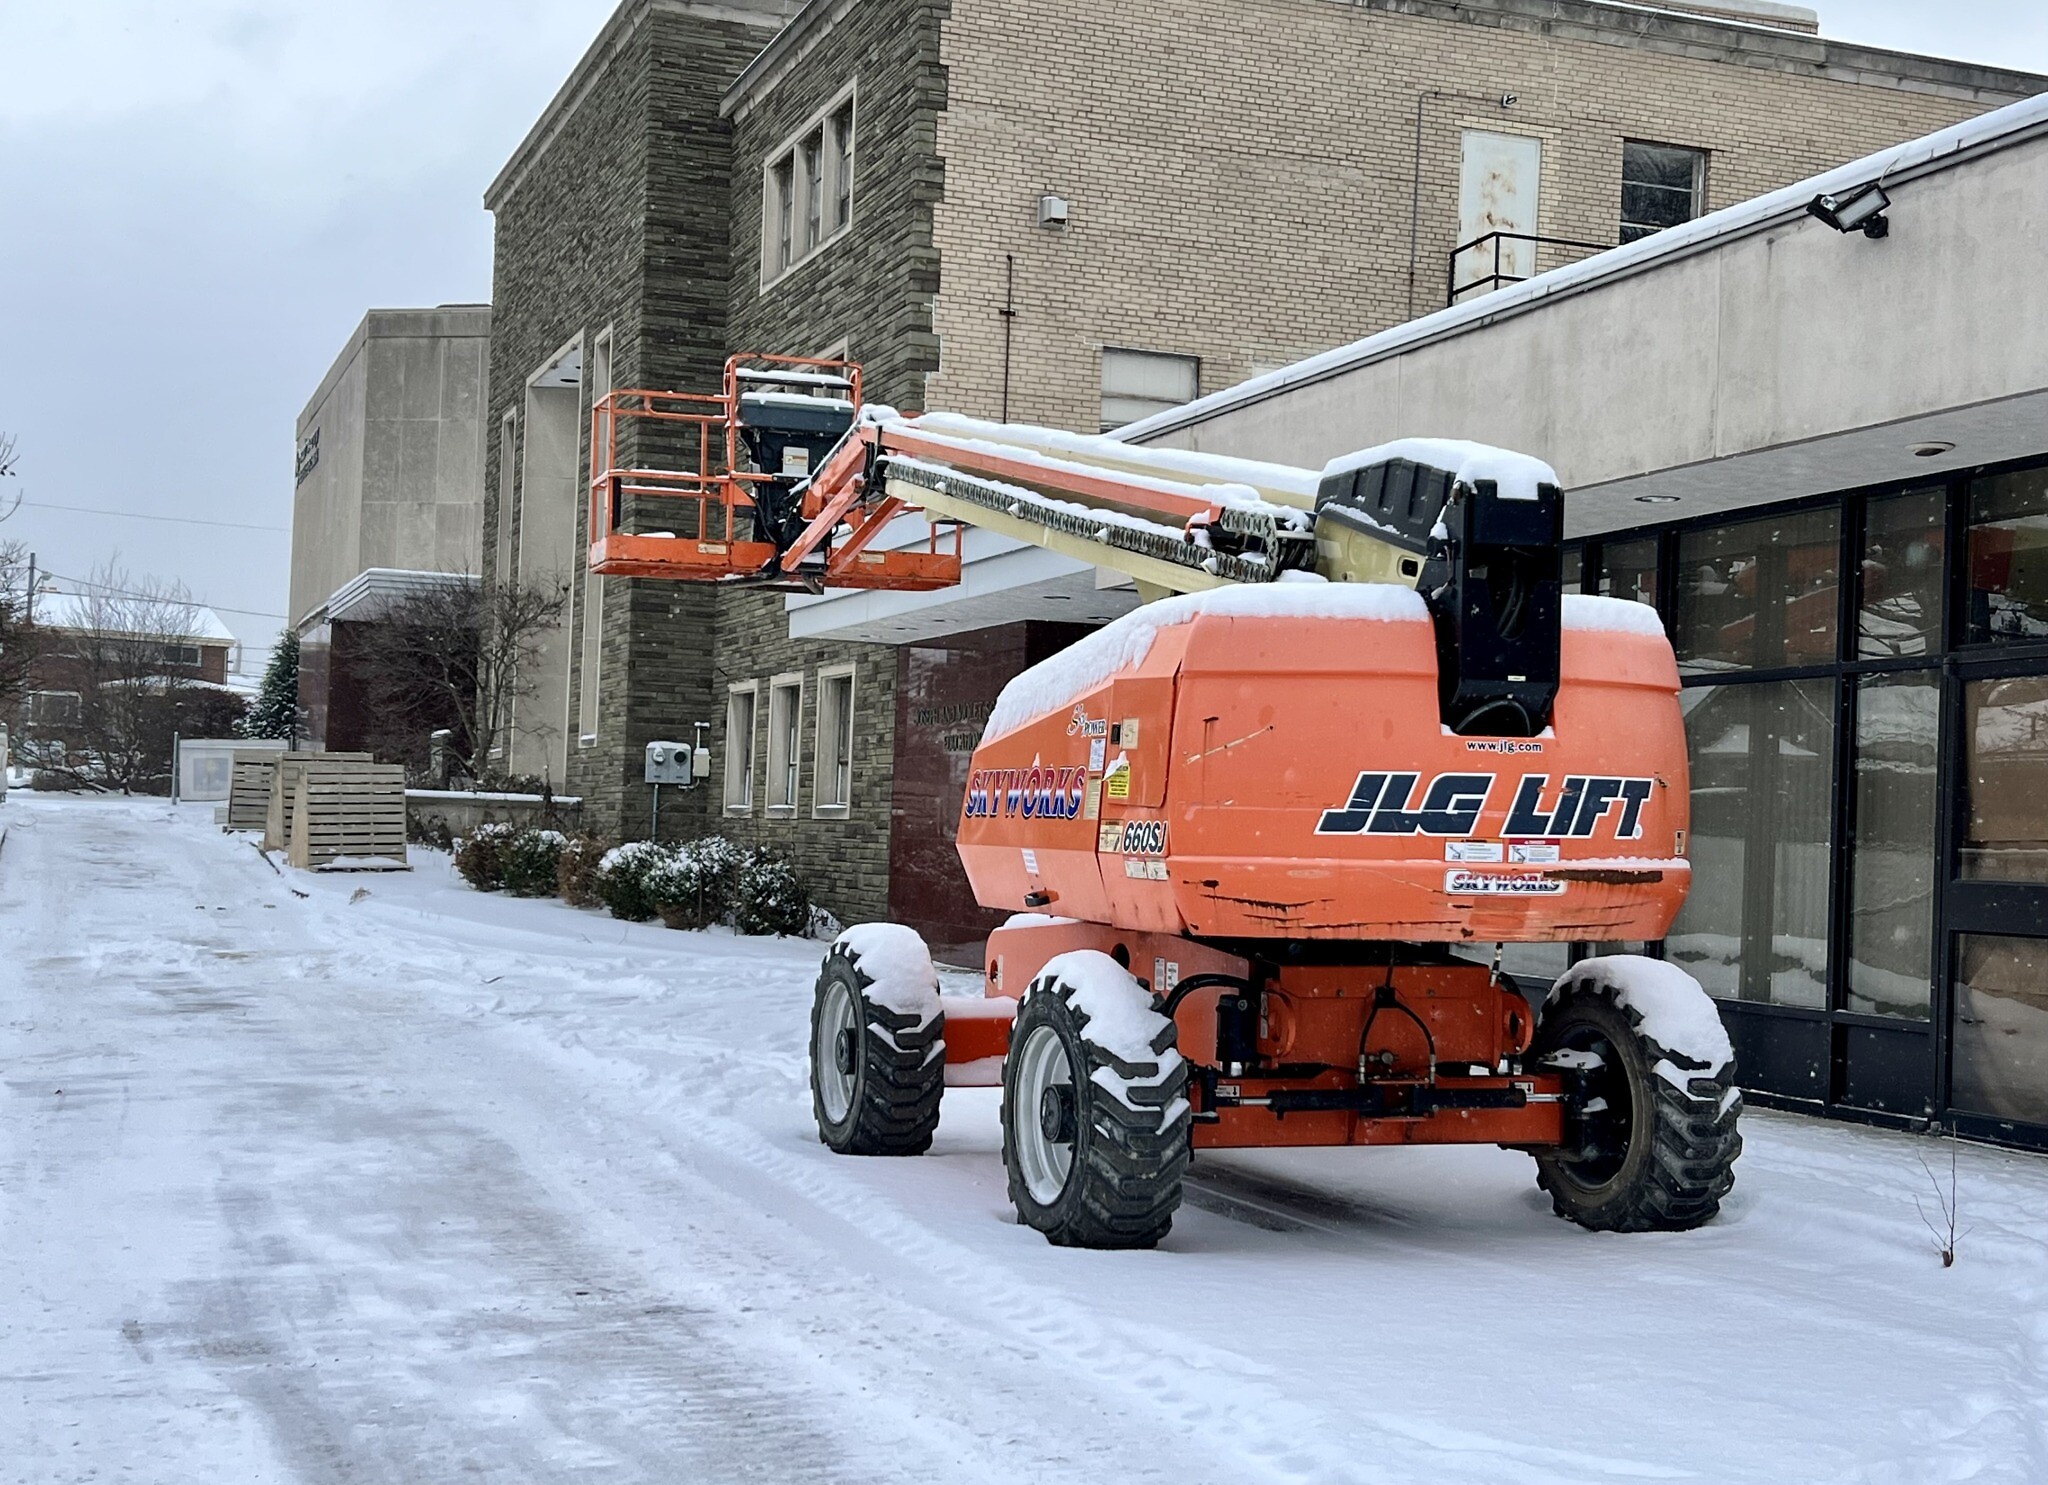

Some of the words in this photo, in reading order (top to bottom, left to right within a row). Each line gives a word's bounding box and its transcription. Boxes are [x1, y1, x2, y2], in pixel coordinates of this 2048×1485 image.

[1466, 740, 1543, 753] www.jlg.com
[964, 765, 1087, 821] SKYWORKS
[1313, 771, 1497, 836] JLG
[1499, 773, 1654, 839] LIFT
[1122, 820, 1168, 854] 660SJ
[1451, 872, 1560, 892] SKYWORKS
